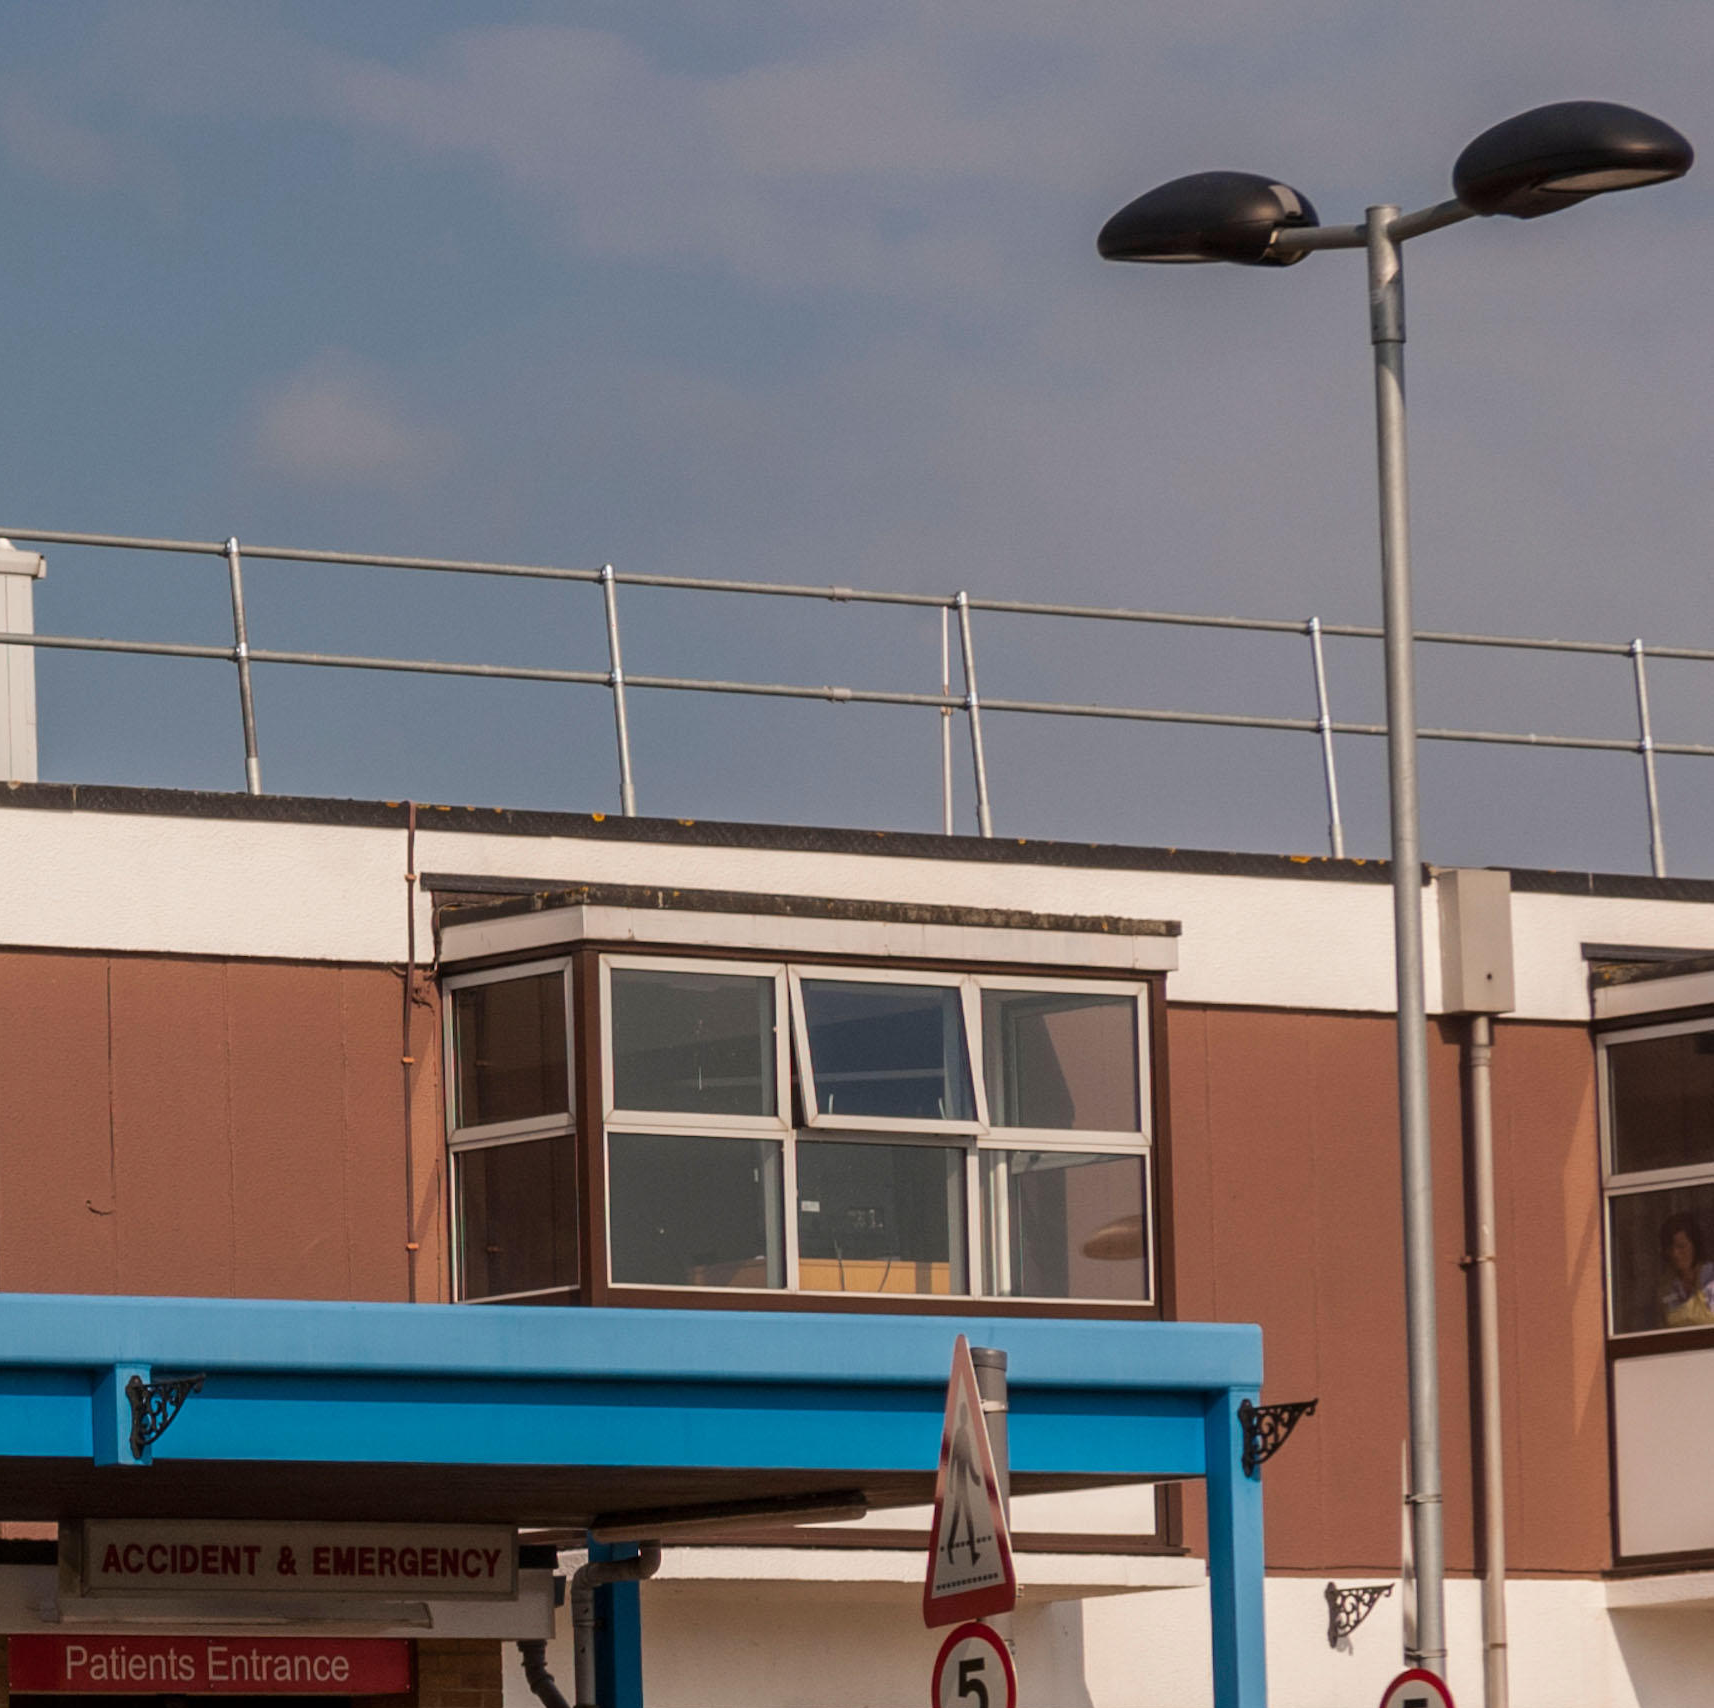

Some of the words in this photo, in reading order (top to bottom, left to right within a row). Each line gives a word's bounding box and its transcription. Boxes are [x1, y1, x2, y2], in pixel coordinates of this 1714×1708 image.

[102, 1543, 261, 1576] ACCIDENT
[276, 1545, 298, 1576] &
[312, 1546, 502, 1579] EMERGENCY
[66, 1645, 195, 1682] Patients
[207, 1646, 350, 1682] Entrance
